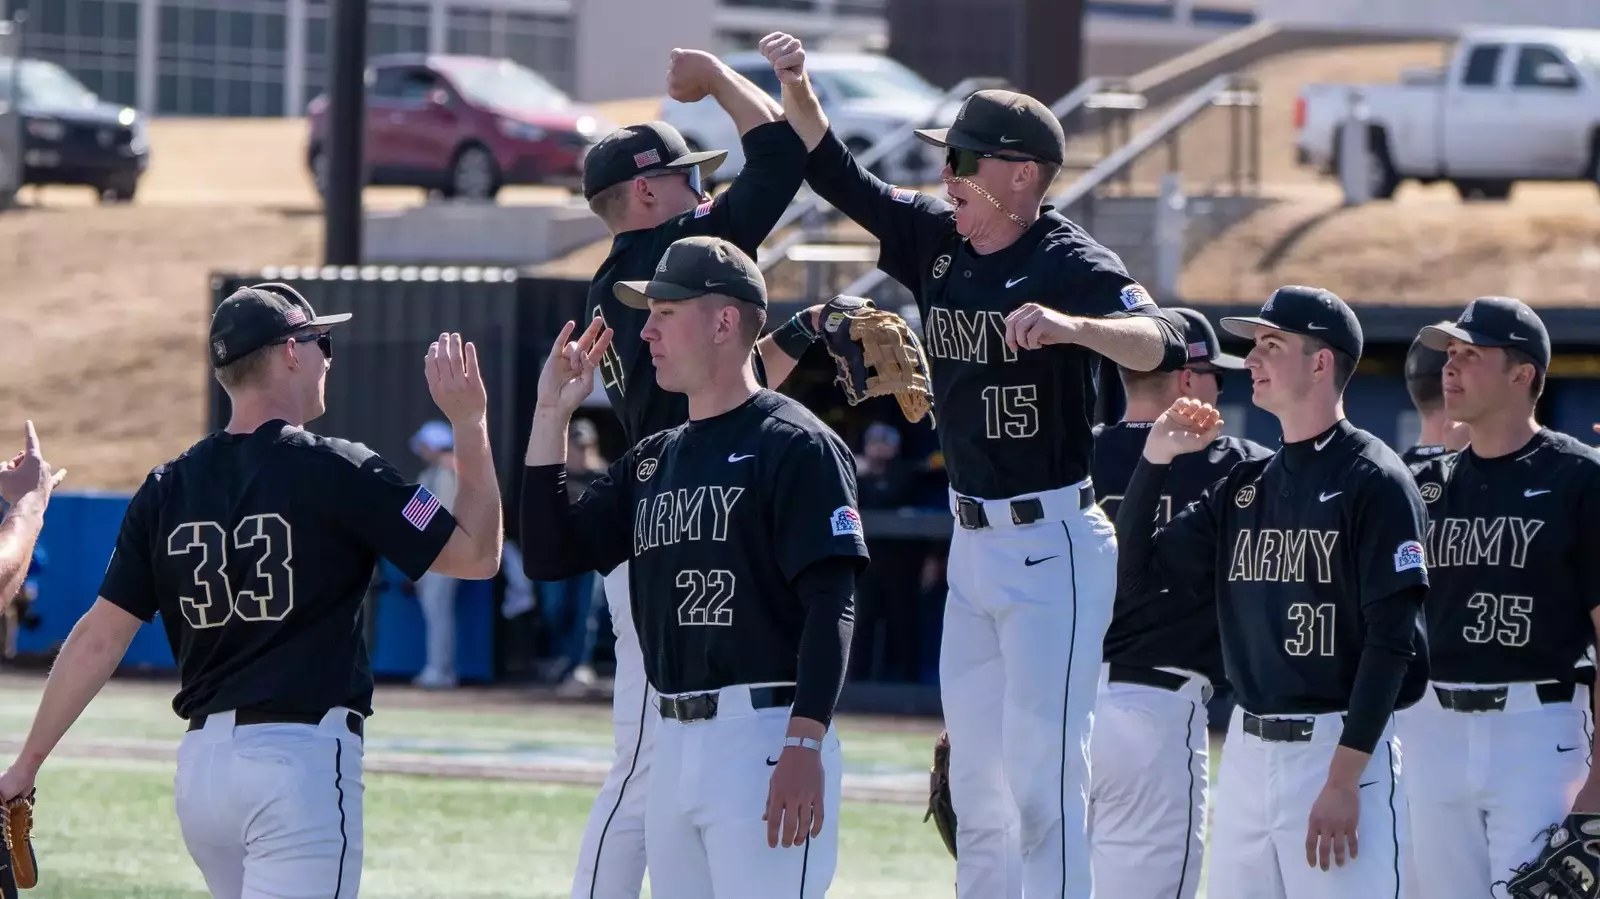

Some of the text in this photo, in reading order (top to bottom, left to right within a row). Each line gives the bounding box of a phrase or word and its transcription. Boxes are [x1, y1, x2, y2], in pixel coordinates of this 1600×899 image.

[934, 258, 948, 274] 20
[981, 384, 1039, 439] 15
[639, 463, 655, 476] 20
[1237, 490, 1253, 503] 20
[1421, 486, 1439, 499] 20
[634, 486, 746, 557] ARMY
[1425, 516, 1546, 569] ARMY
[167, 513, 294, 629] 33
[1228, 529, 1340, 583] ARMY
[675, 569, 736, 627] 22
[1462, 592, 1534, 647] 35
[1284, 603, 1336, 657] 31
